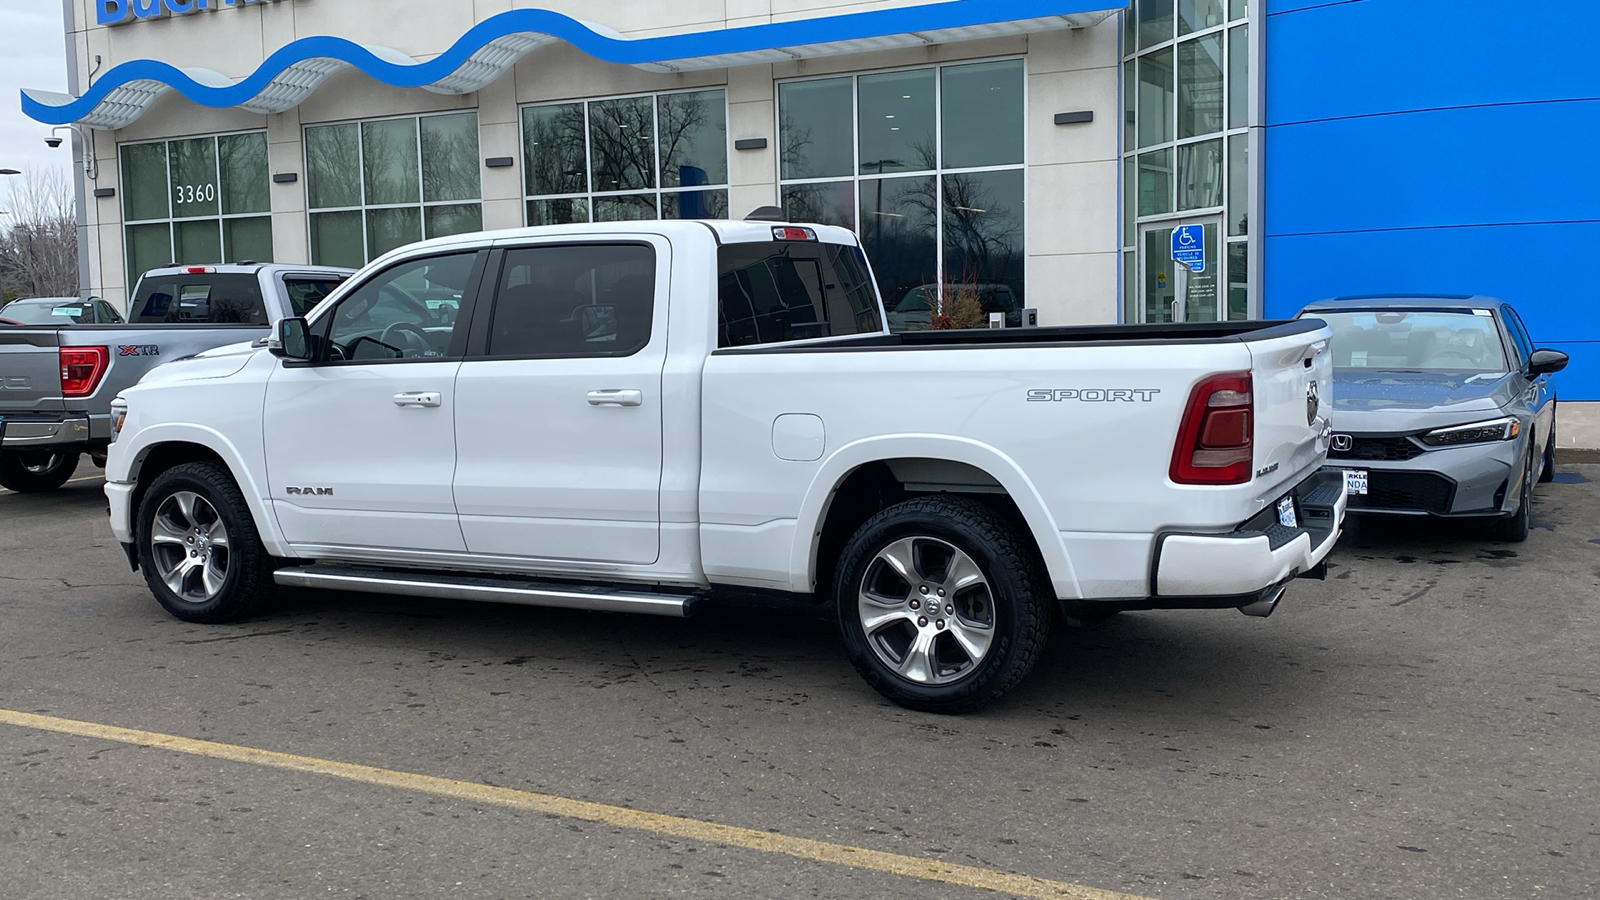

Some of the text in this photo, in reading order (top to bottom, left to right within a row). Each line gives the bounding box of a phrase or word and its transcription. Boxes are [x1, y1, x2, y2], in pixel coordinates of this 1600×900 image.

[176, 183, 215, 204] 3360
[118, 344, 160, 356] XTR
[1026, 388, 1161, 402] SPORT
[286, 486, 334, 496] RAM
